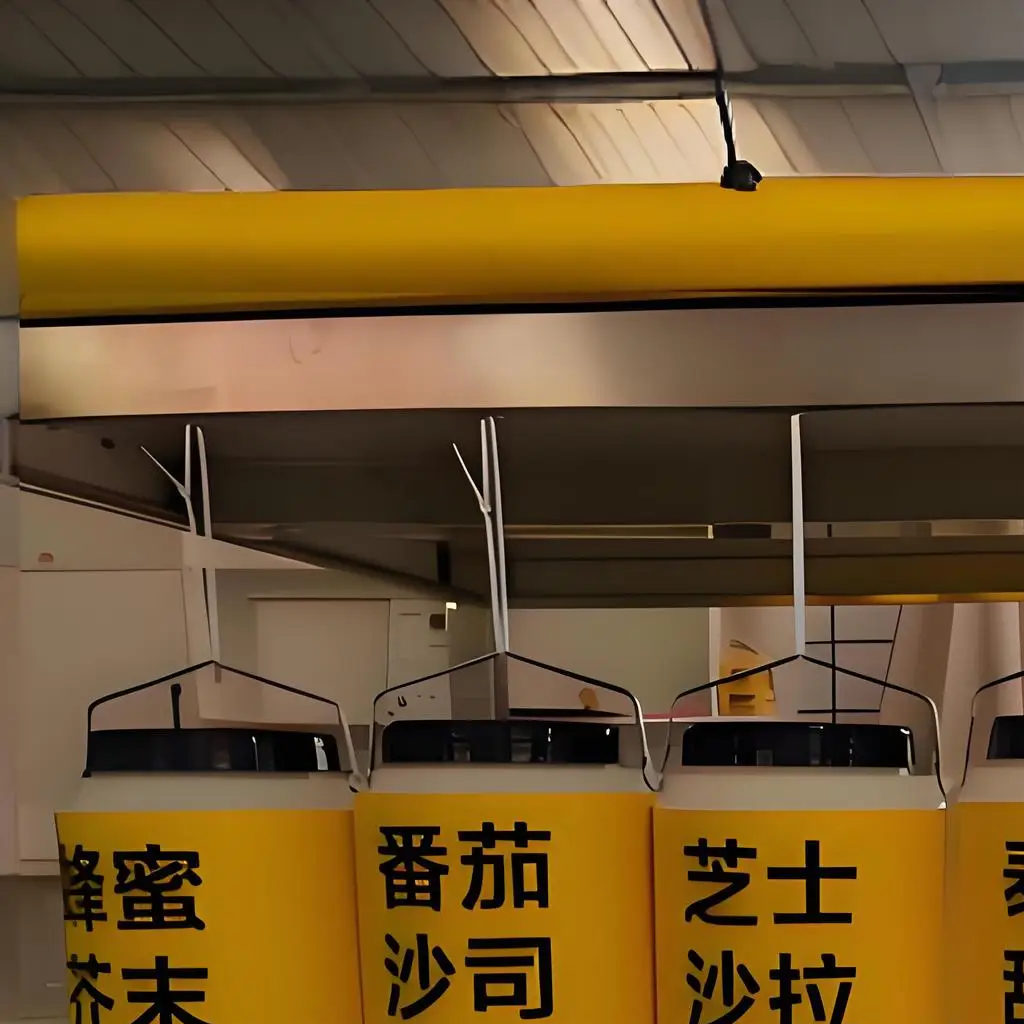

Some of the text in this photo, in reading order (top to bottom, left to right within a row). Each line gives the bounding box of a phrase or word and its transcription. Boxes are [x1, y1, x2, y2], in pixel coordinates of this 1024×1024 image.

[377, 821, 552, 911] 番茄
[683, 837, 858, 926] 芝士
[383, 932, 554, 1020] 沙司
